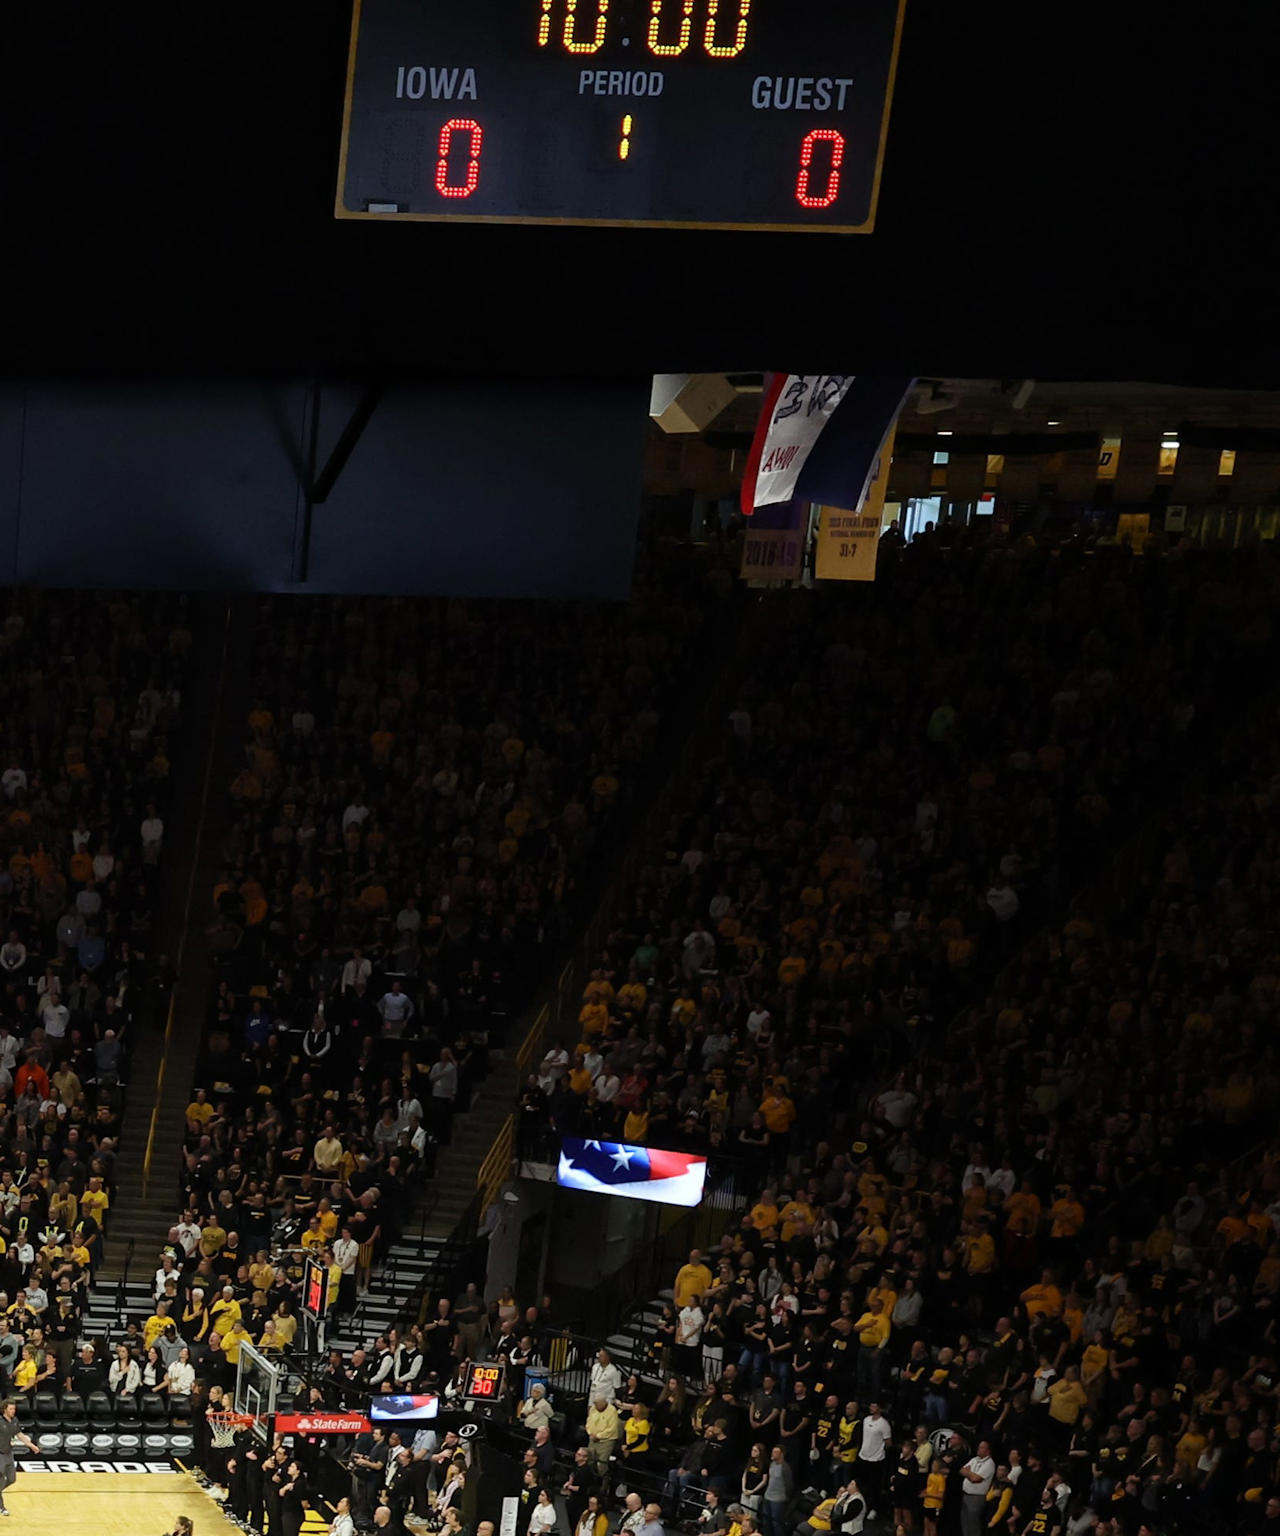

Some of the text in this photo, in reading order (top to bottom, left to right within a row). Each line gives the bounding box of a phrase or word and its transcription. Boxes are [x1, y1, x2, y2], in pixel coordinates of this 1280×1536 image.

[395, 66, 478, 101] IOWA
[578, 70, 664, 97] PERIOD
[751, 76, 853, 111] GUEST
[619, 114, 633, 160] 1
[435, 118, 483, 199] 0
[796, 128, 844, 208] 0
[473, 1380, 492, 1395] 30
[475, 1368, 499, 1381] 10:00
[1032, 1520, 1046, 1533] 22
